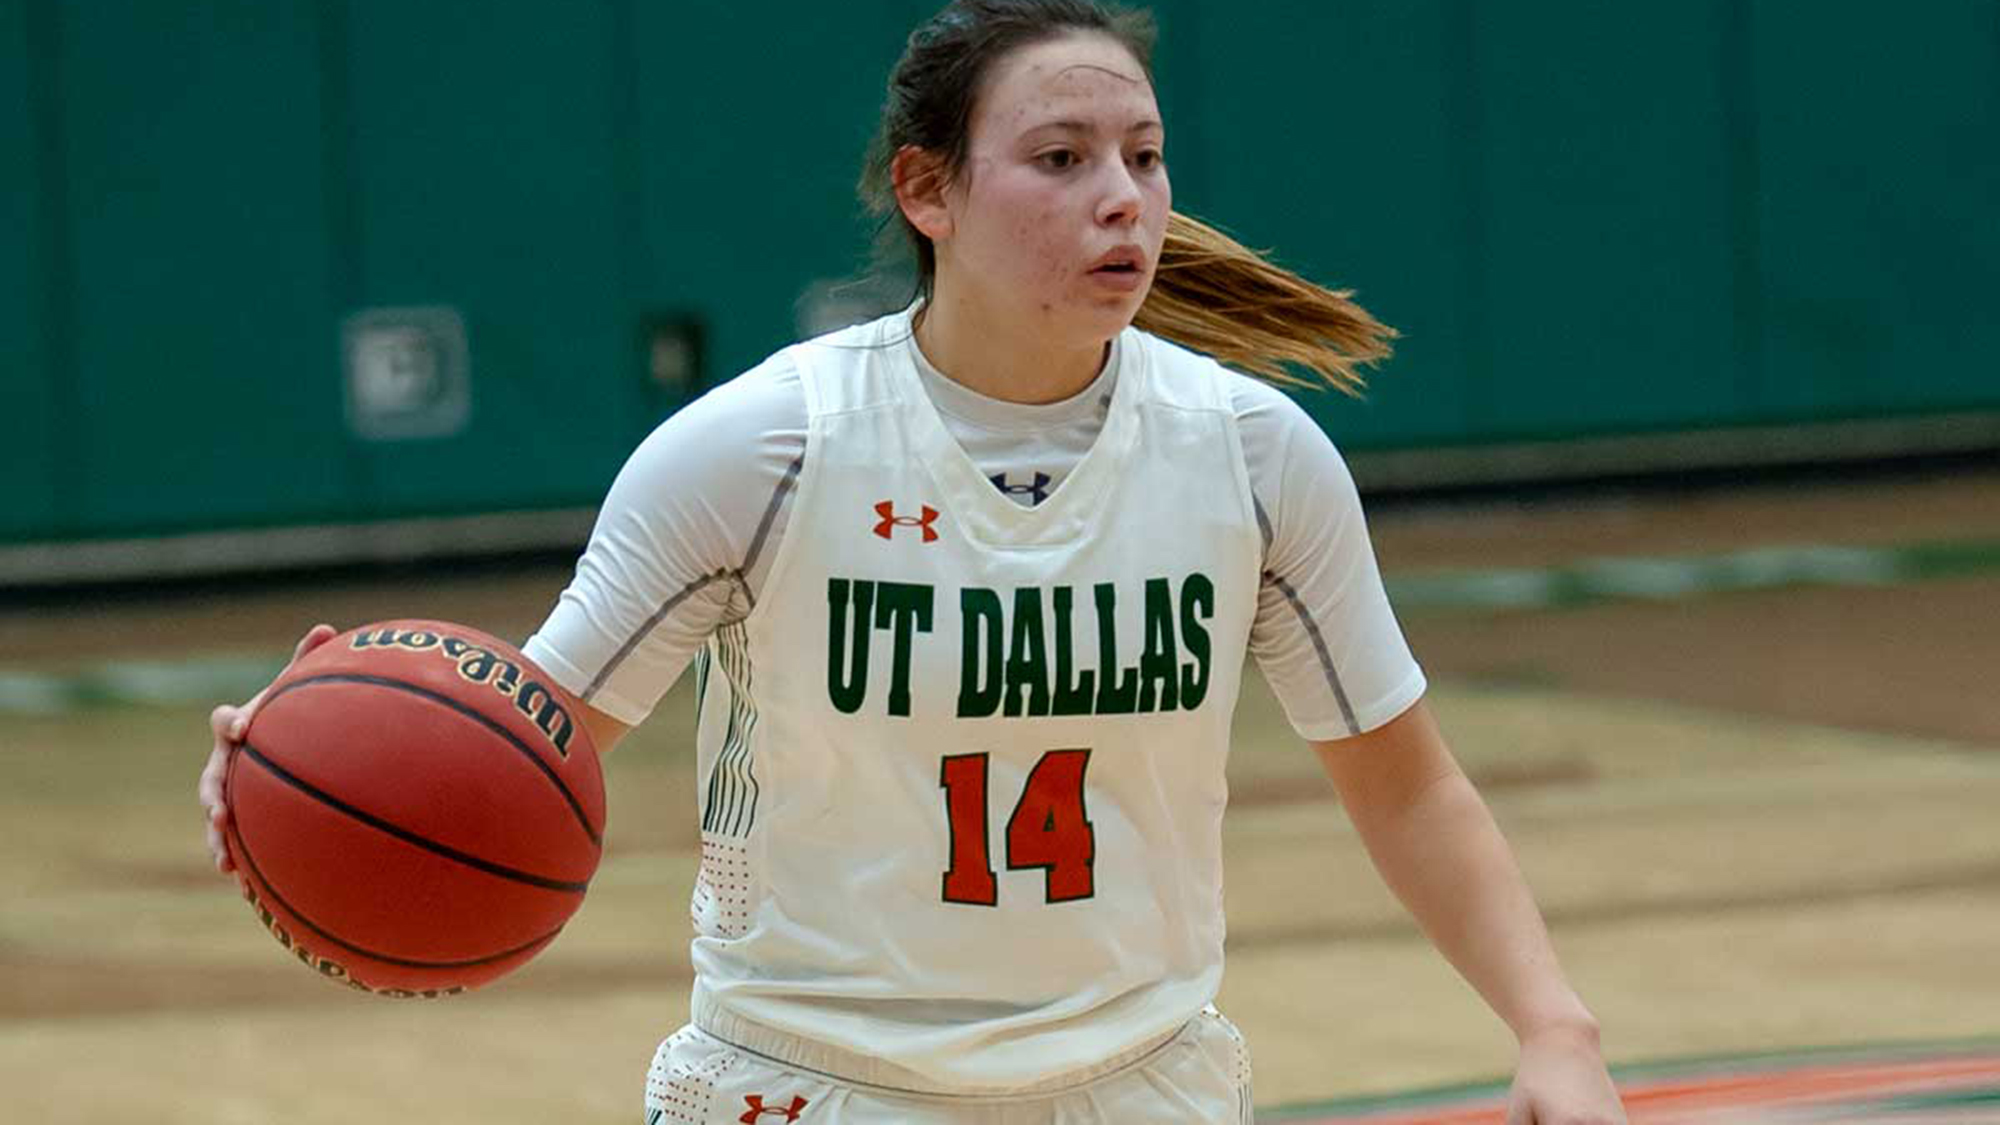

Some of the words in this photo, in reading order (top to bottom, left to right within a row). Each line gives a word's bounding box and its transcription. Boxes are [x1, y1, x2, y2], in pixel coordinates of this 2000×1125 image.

[350, 629, 575, 759] Wilson
[828, 578, 934, 717] UT
[957, 572, 1214, 718] DALLAS
[940, 749, 1095, 907] 14
